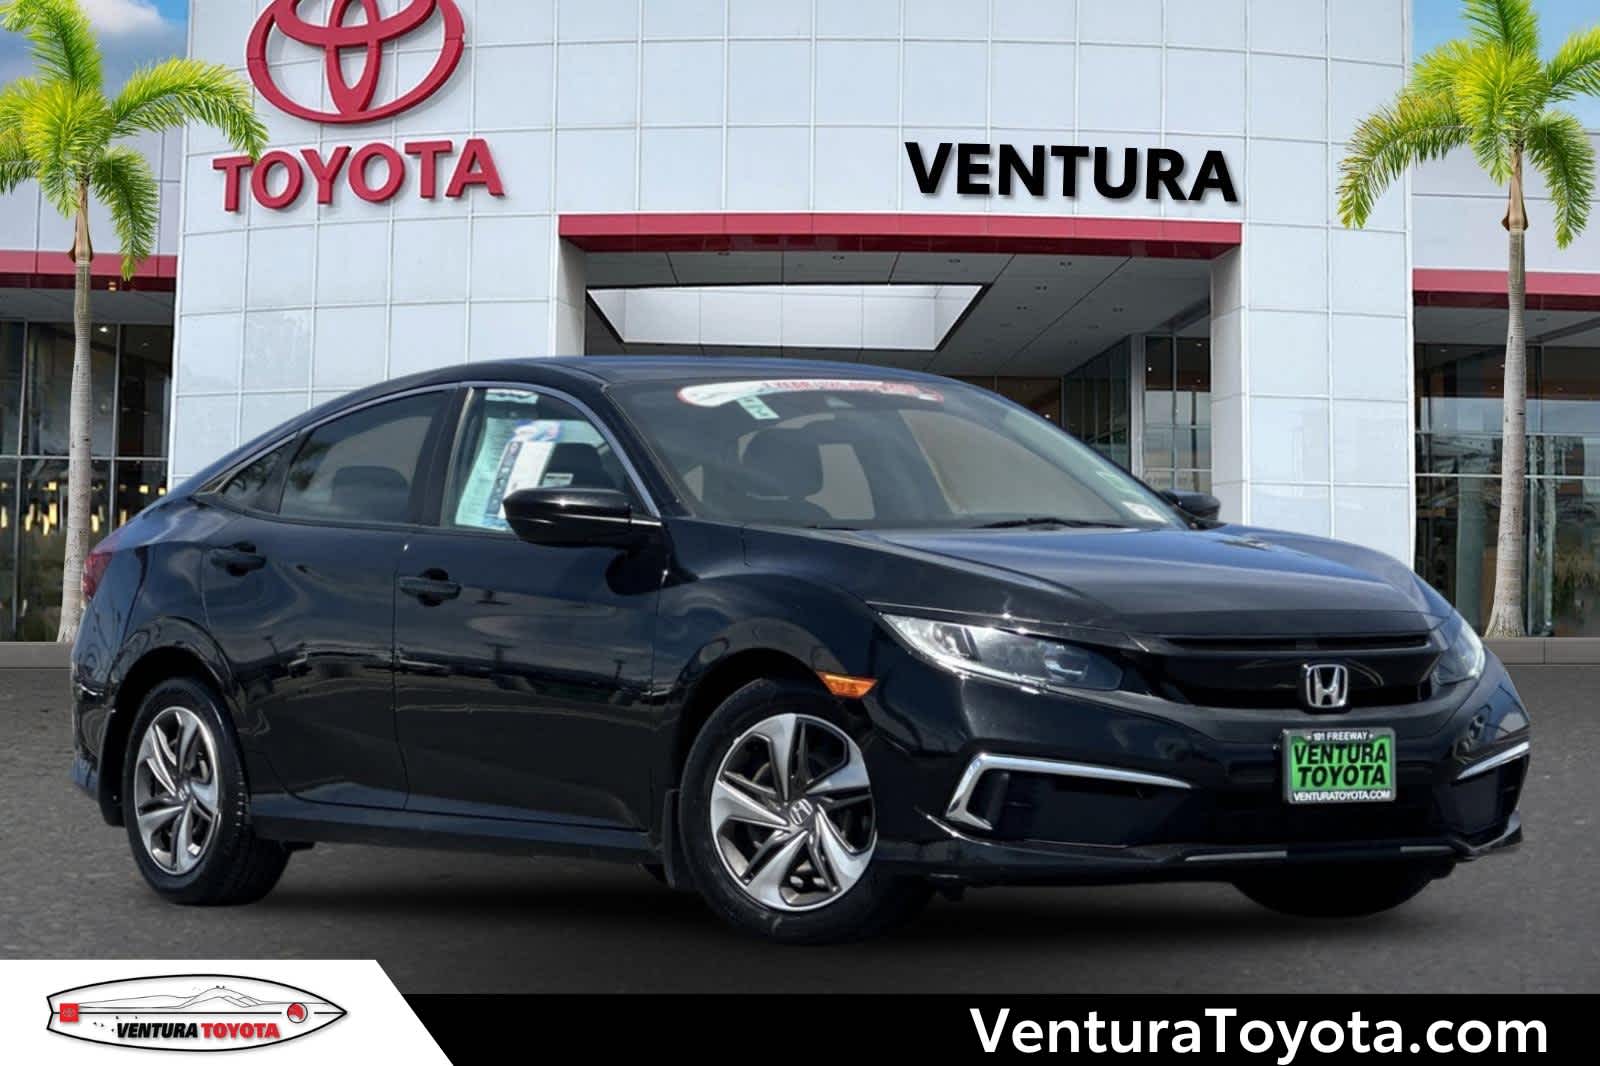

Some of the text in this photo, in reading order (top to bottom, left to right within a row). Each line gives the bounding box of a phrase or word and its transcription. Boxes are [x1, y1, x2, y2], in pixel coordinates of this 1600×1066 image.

[213, 138, 505, 212] TOYOTA
[904, 142, 1238, 202] VENTURA
[1327, 732, 1367, 741] FREEWAY
[1294, 743, 1387, 764] VENTURA
[1298, 765, 1386, 787] TOYOTA
[1294, 790, 1391, 801] VENTURATOYOTA.COM
